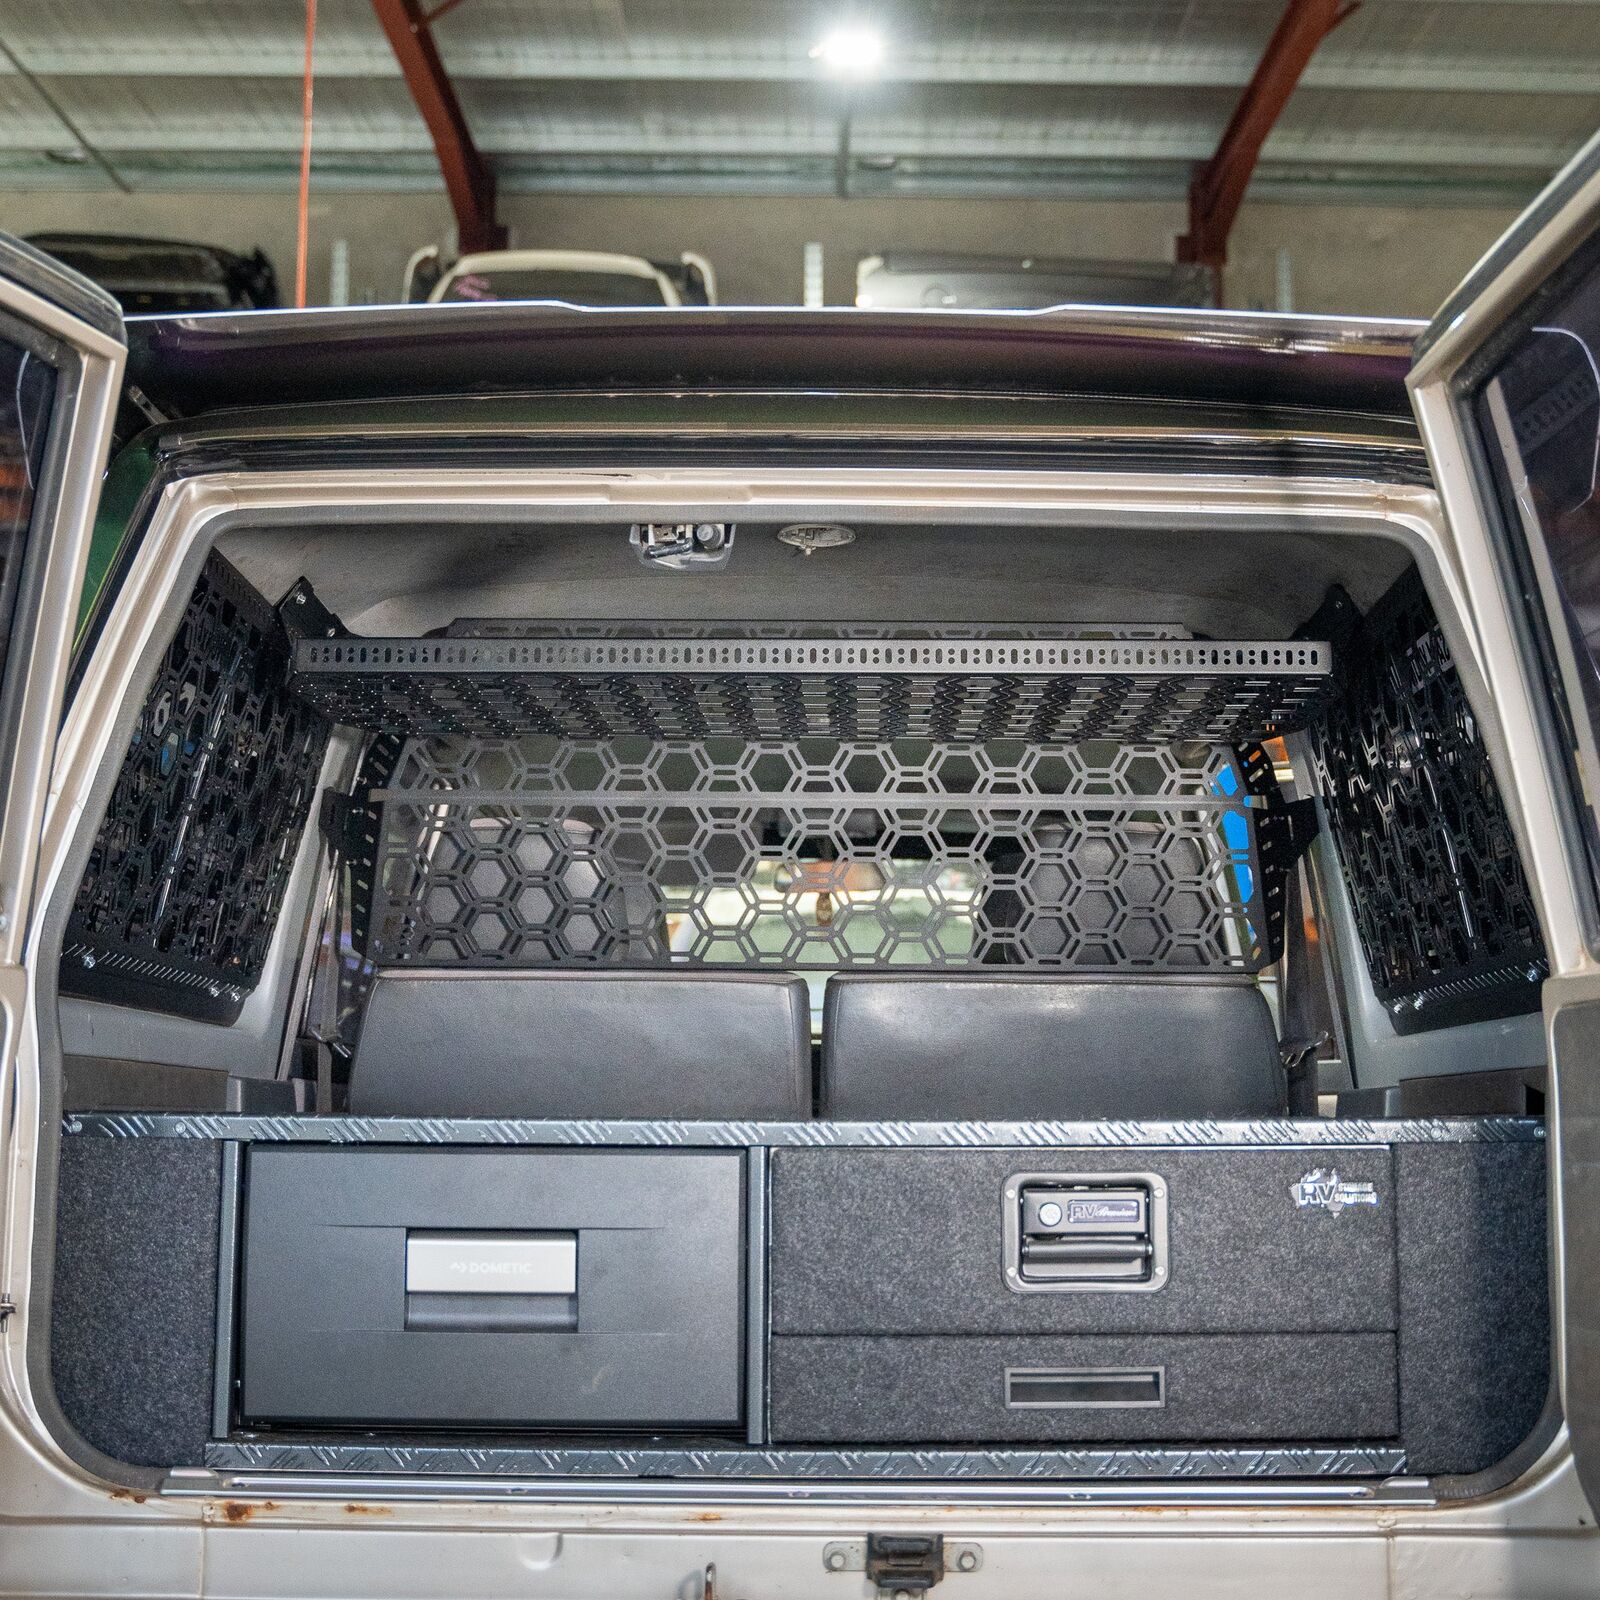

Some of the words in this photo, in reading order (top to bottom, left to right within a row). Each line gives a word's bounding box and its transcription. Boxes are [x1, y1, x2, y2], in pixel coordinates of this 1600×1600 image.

[1298, 1182, 1336, 1205] RV
[1070, 1204, 1097, 1219] RV
[468, 1262, 533, 1274] DOMETIC
